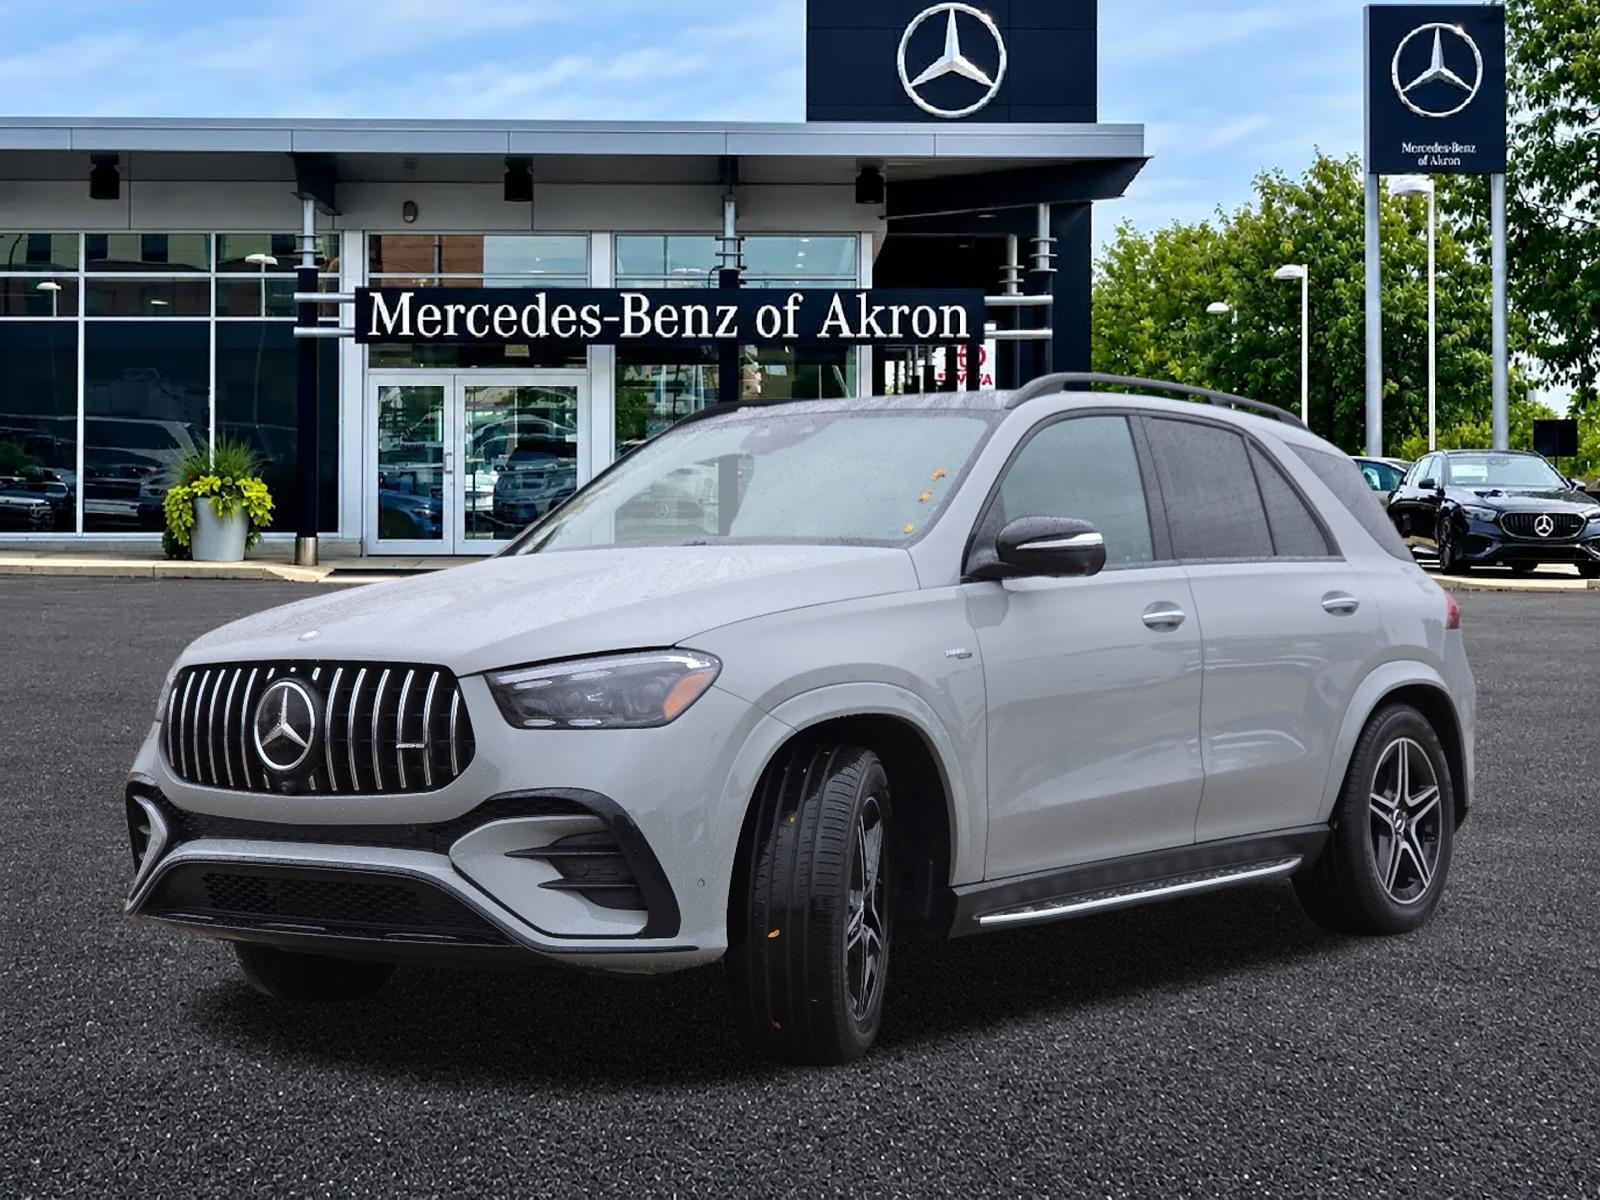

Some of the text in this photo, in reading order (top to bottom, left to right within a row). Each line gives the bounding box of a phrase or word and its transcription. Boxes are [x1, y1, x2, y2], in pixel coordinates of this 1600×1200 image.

[1401, 141, 1477, 154] Mercedes-Benz
[1417, 154, 1461, 166] of Akron
[367, 291, 970, 338] Mercedes-Benz of Akron
